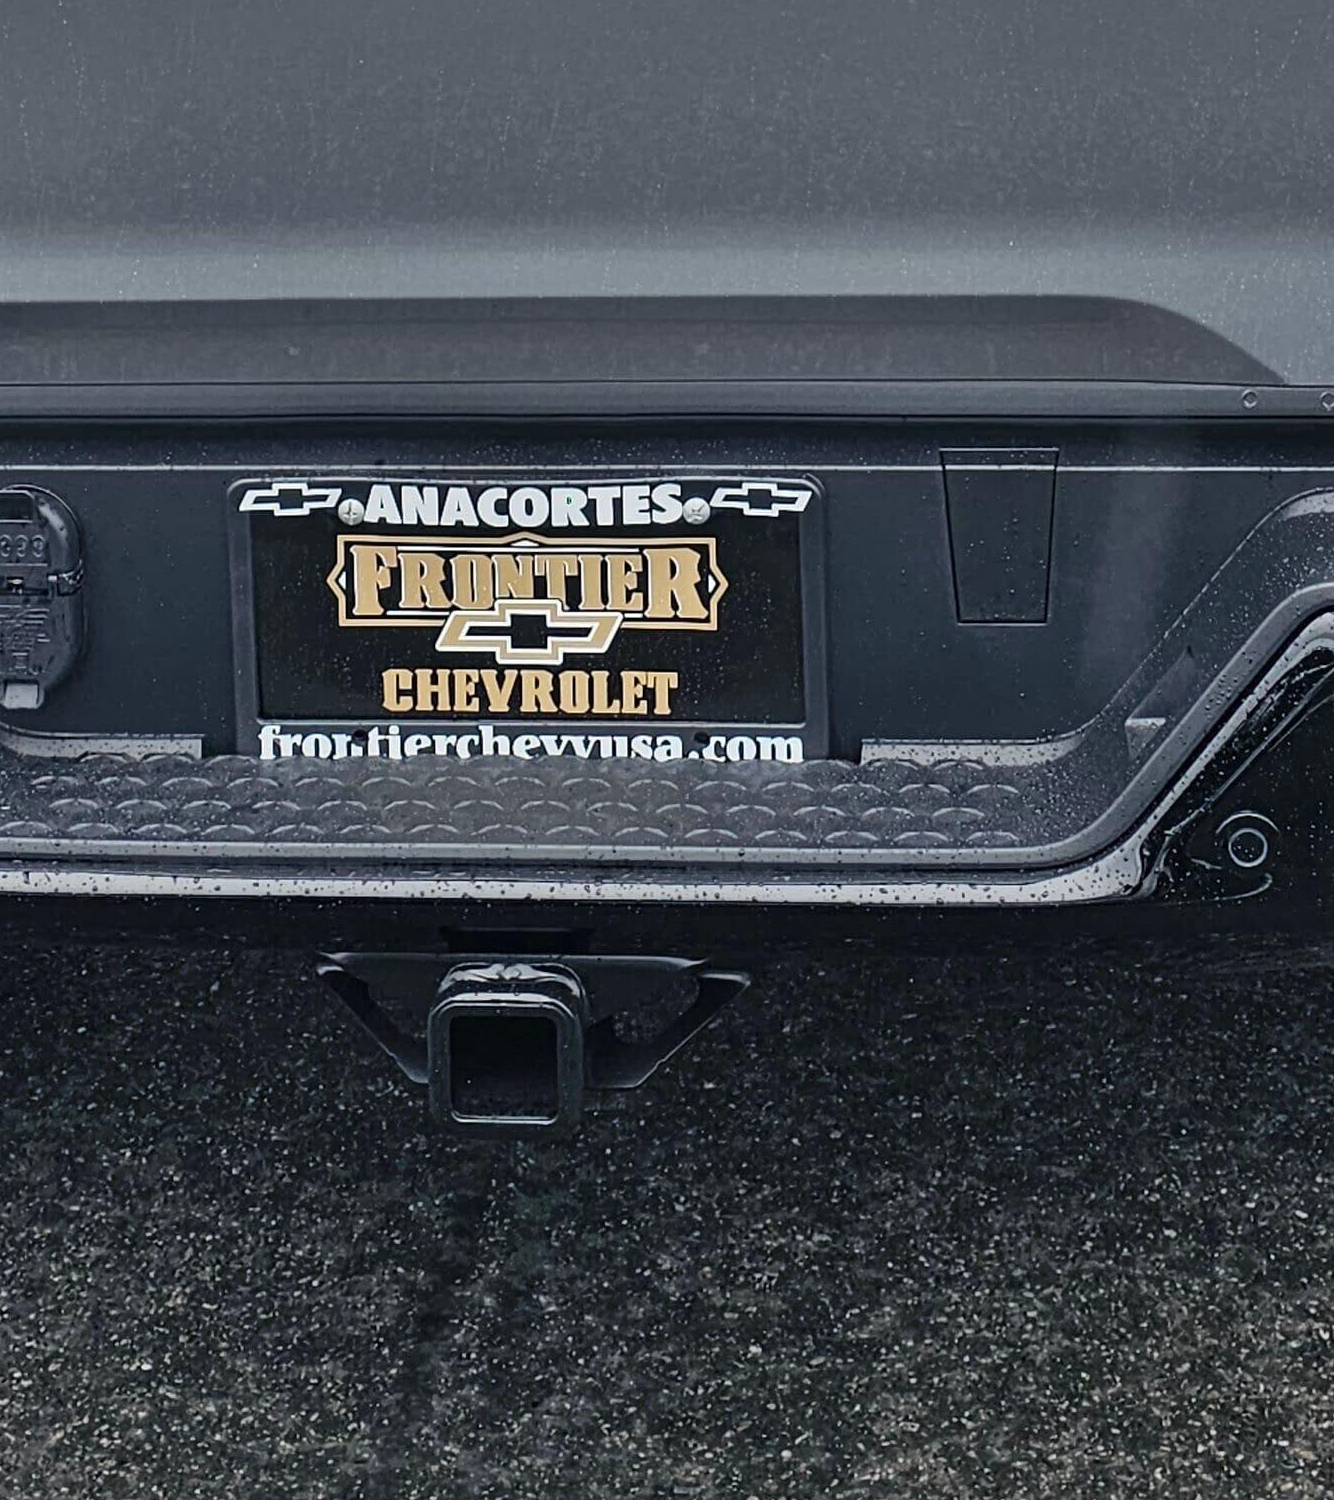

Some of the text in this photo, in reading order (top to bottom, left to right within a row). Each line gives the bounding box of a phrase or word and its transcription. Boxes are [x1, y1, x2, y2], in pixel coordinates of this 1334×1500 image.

[363, 483, 684, 528] ANACORTES
[350, 544, 708, 620] FRONTIER
[381, 667, 679, 715] CHEVROLET
